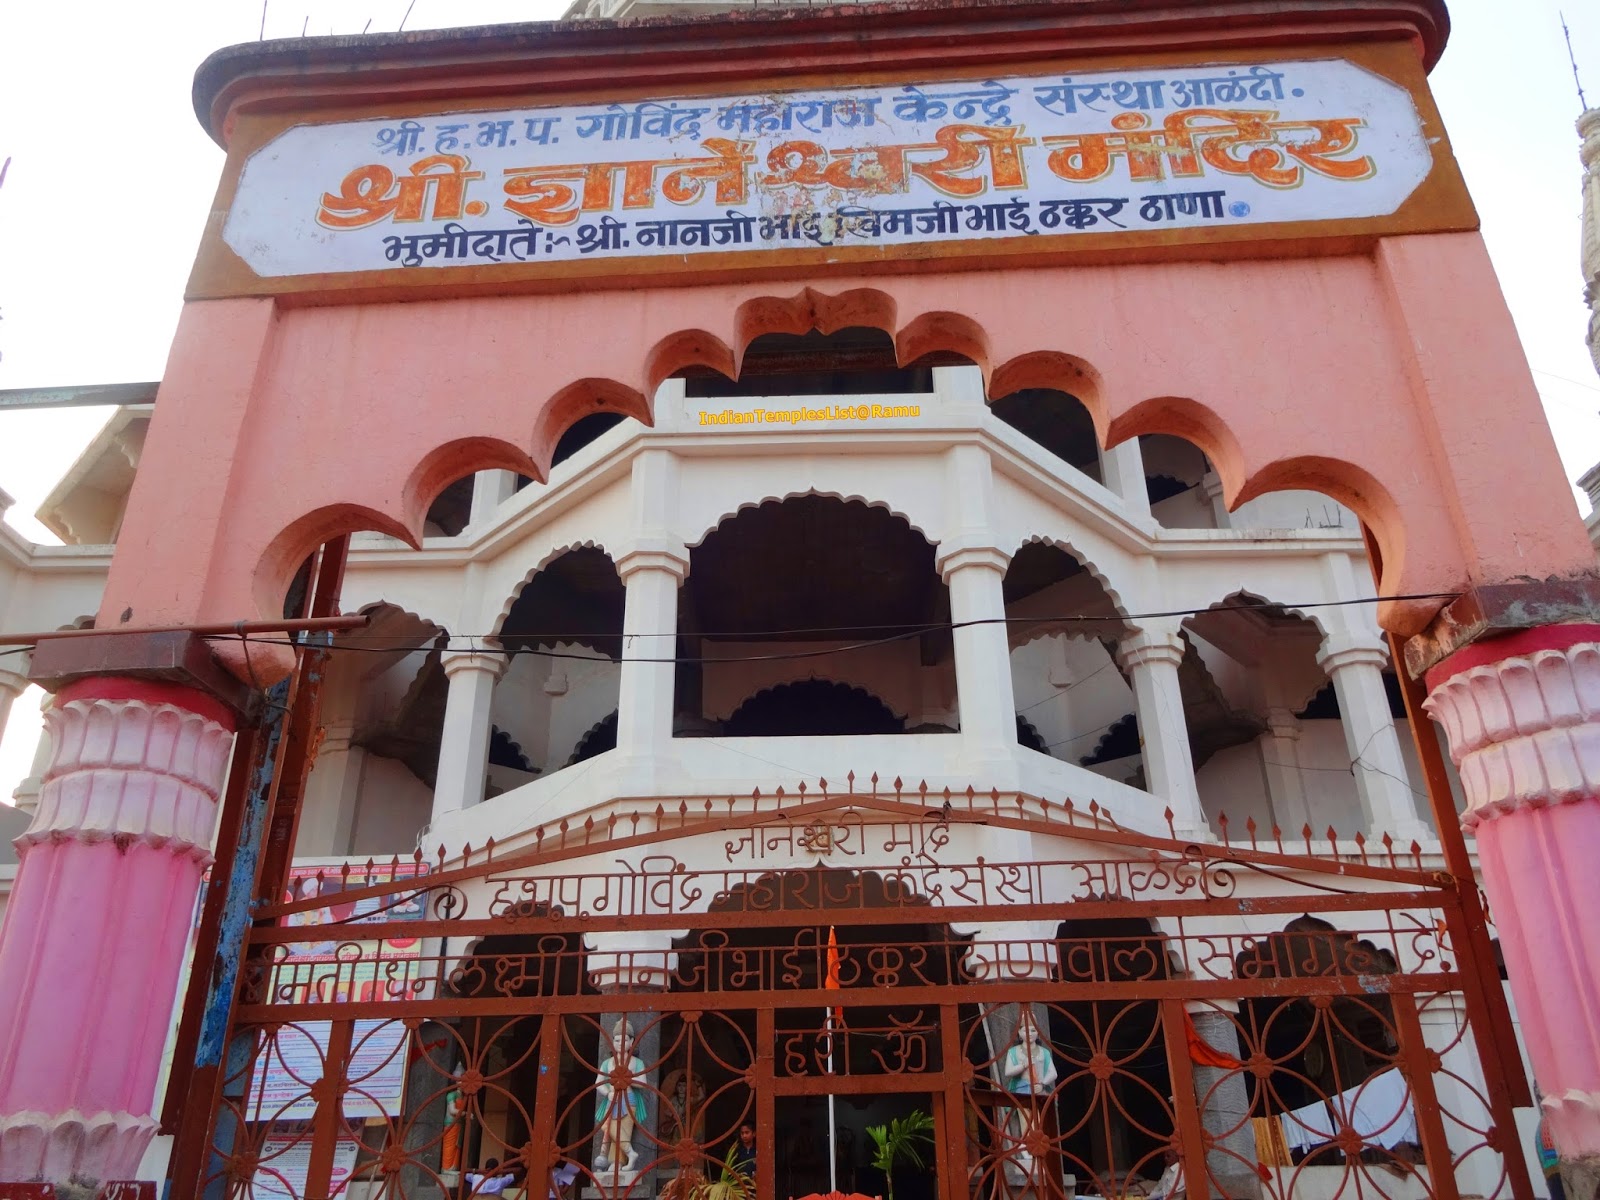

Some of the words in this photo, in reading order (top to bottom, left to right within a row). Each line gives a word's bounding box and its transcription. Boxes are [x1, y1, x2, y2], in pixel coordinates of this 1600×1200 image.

[576, 102, 711, 141] गोविंद
[716, 95, 882, 135] महाराज
[1033, 77, 1165, 116] संस्था
[1041, 108, 1377, 190] मंदिर
[1039, 197, 1129, 229] ठक्कर
